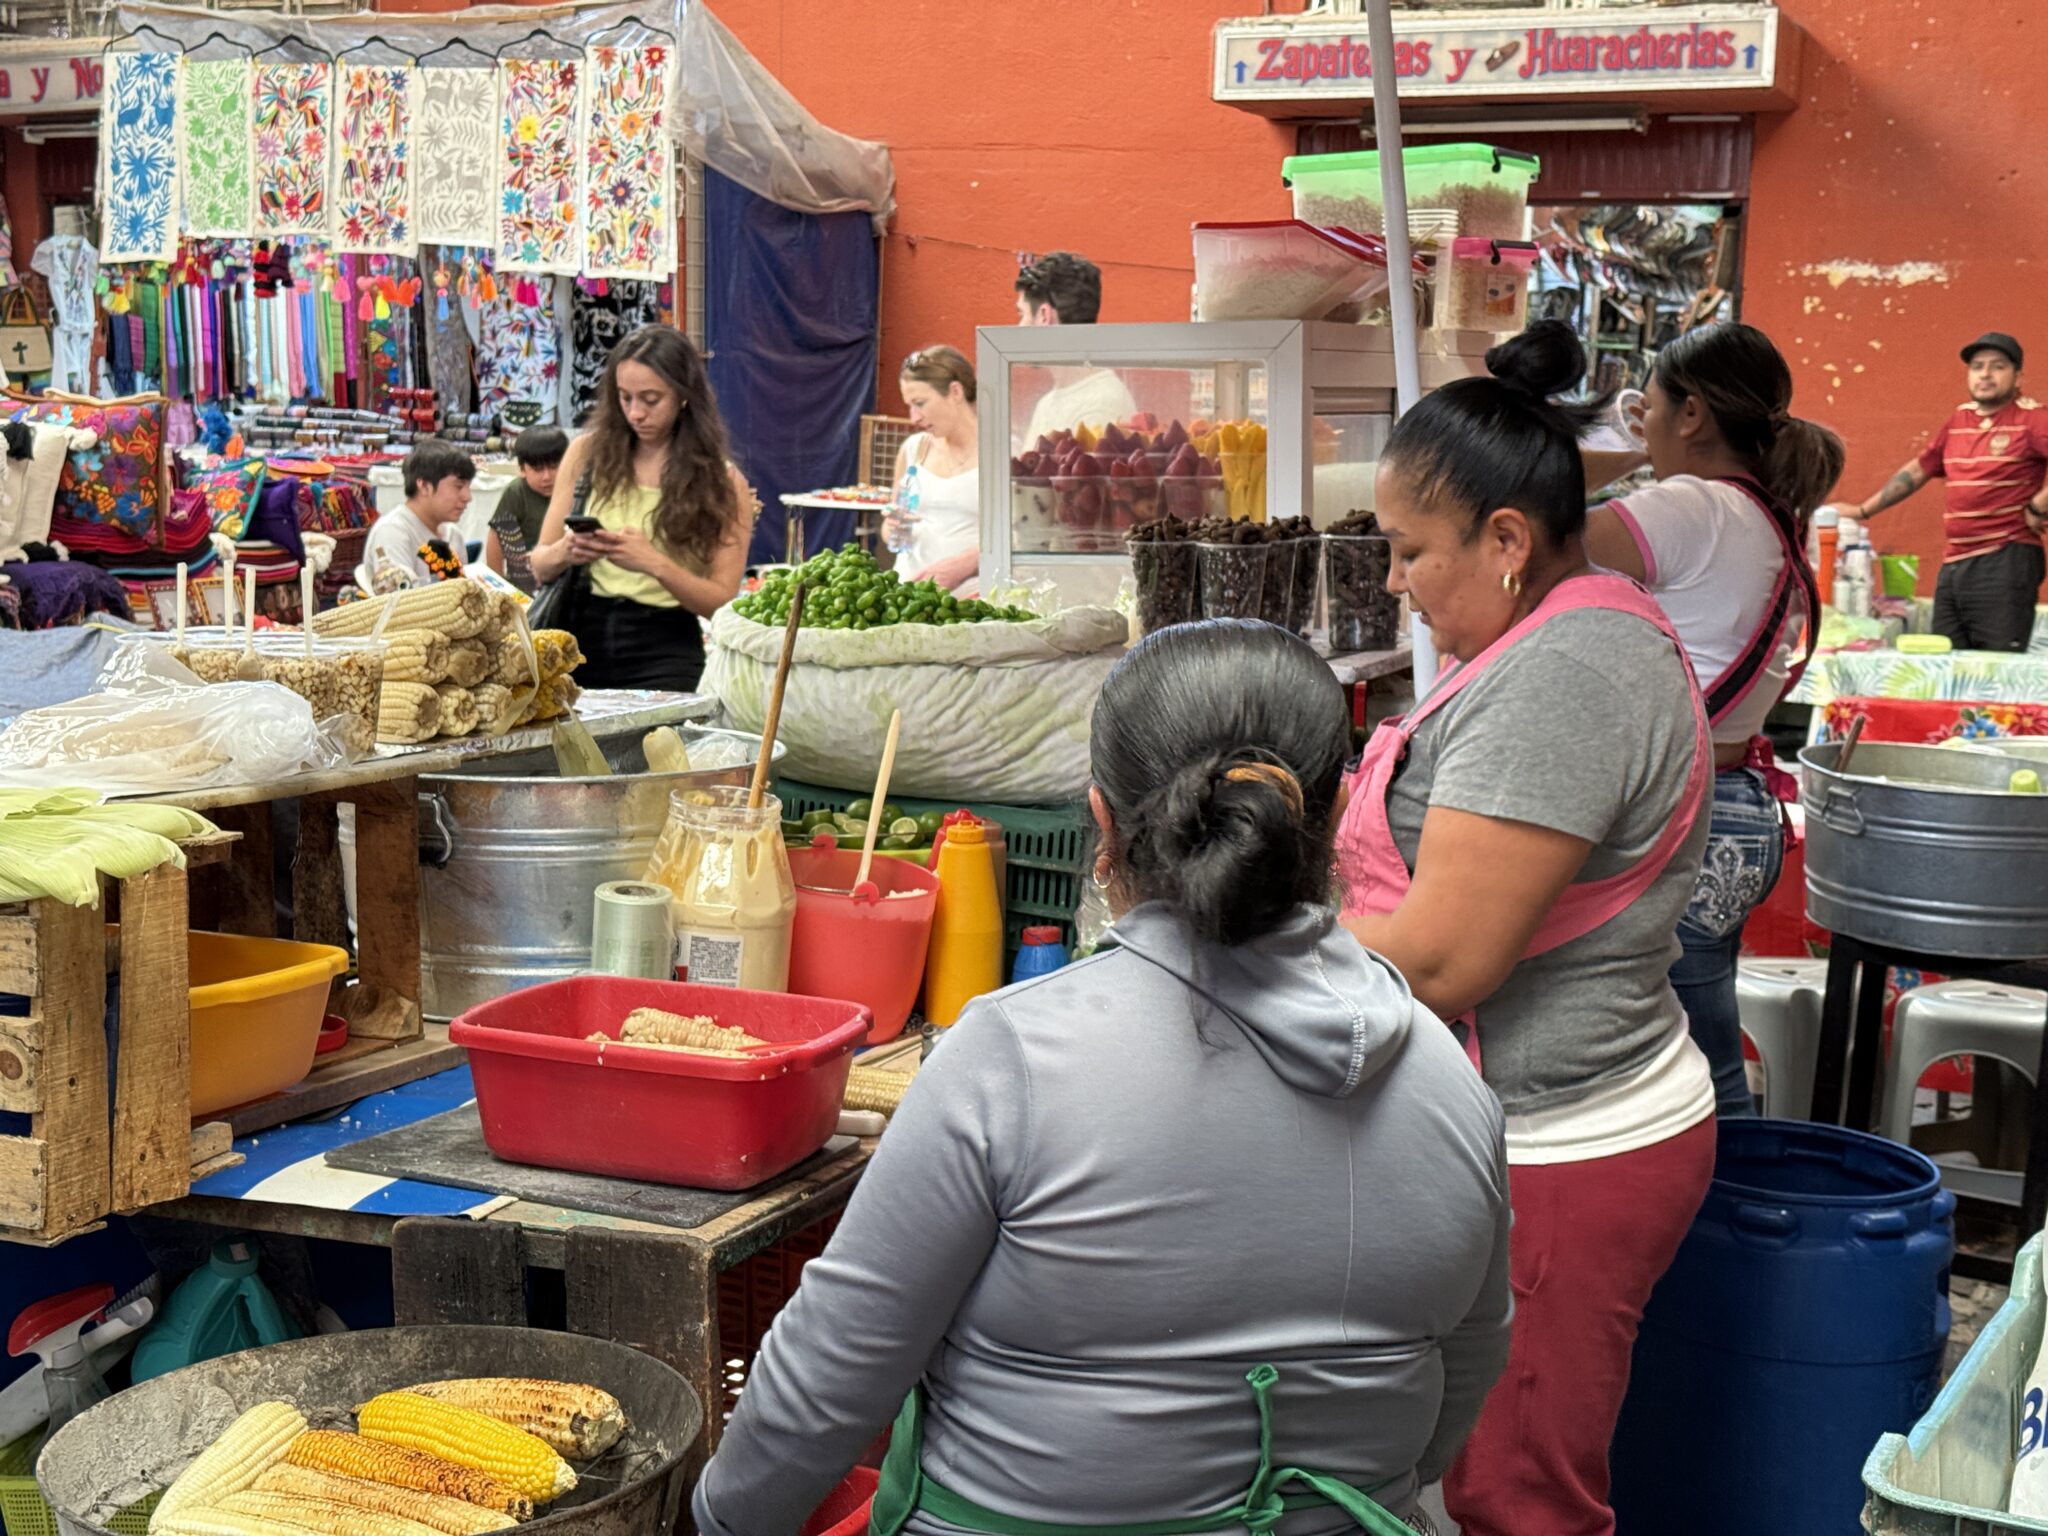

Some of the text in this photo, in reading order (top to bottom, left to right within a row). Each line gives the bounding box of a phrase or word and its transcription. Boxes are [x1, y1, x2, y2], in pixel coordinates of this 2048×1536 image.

[1255, 35, 1433, 86] Zapateas
[1446, 48, 1477, 83] y
[31, 67, 49, 102] y
